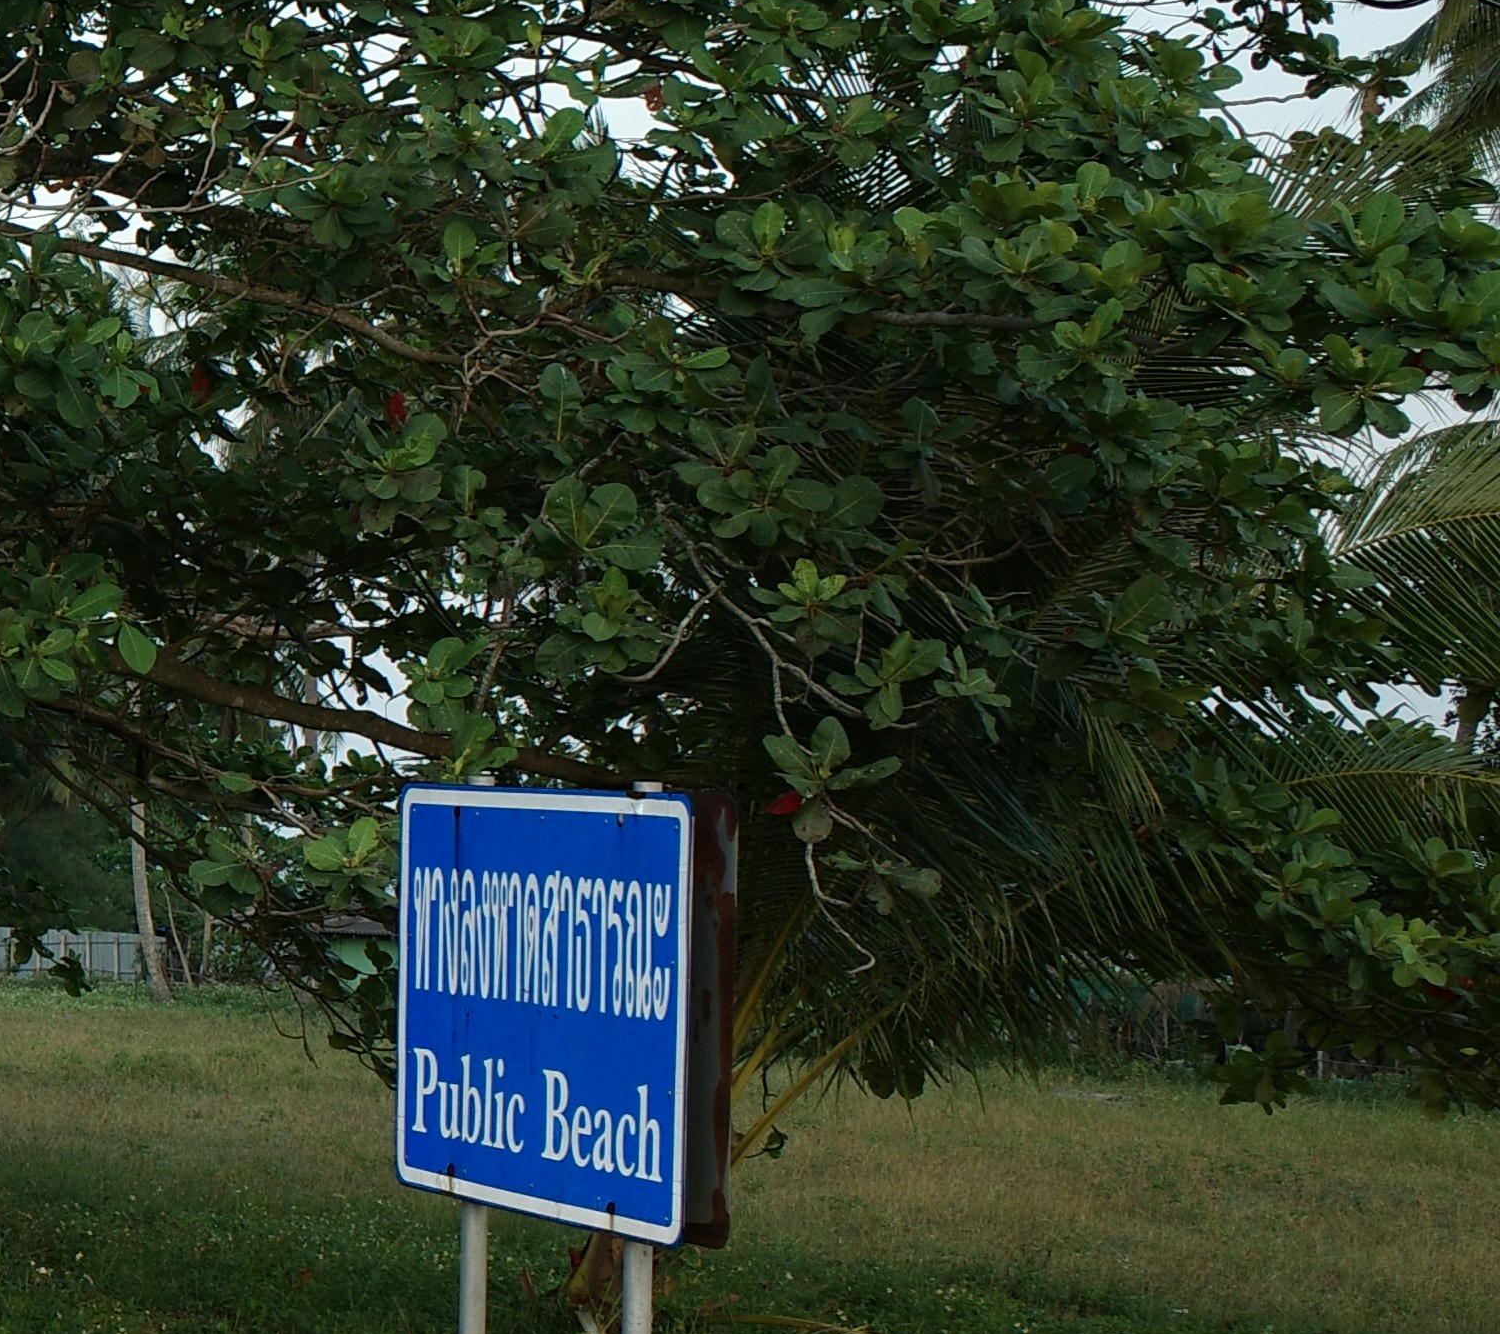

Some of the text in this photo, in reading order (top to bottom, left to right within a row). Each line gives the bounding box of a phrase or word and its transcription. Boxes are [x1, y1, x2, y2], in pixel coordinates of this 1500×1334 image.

[413, 866, 672, 1021] ทางลงหาดสาธารณะ
[411, 1047, 663, 1183] Public Beach
